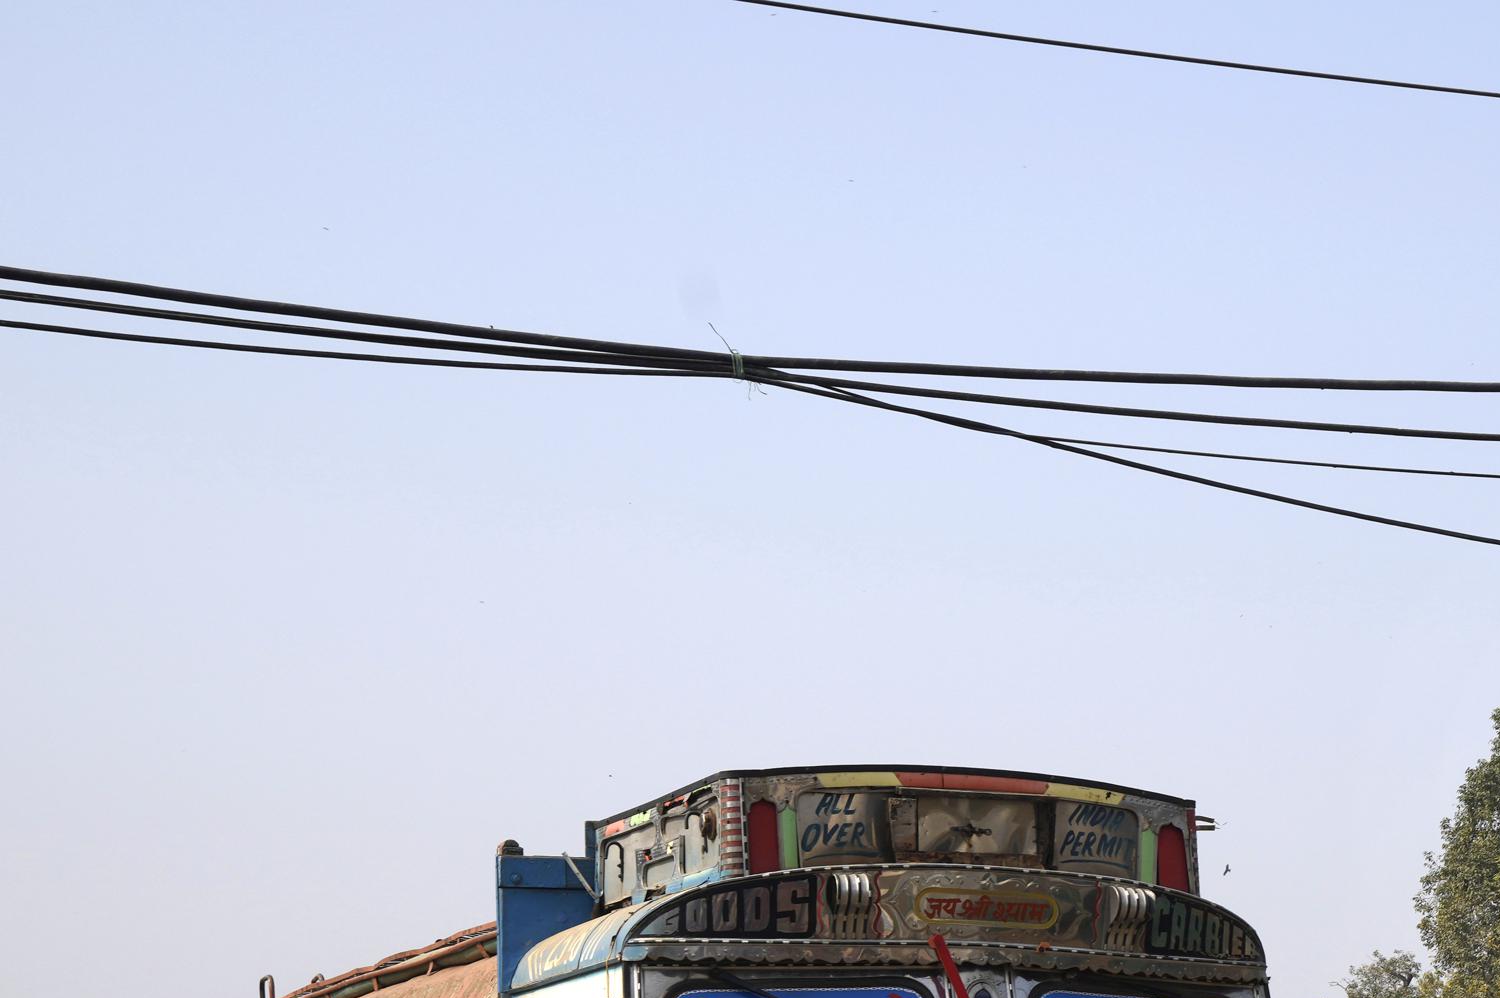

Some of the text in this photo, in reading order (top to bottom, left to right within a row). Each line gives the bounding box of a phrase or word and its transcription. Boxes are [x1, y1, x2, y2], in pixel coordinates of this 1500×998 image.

[815, 793, 856, 816] ALL
[801, 822, 865, 852] OVER
[1060, 830, 1137, 862] PERMIT
[924, 898, 961, 919] जय
